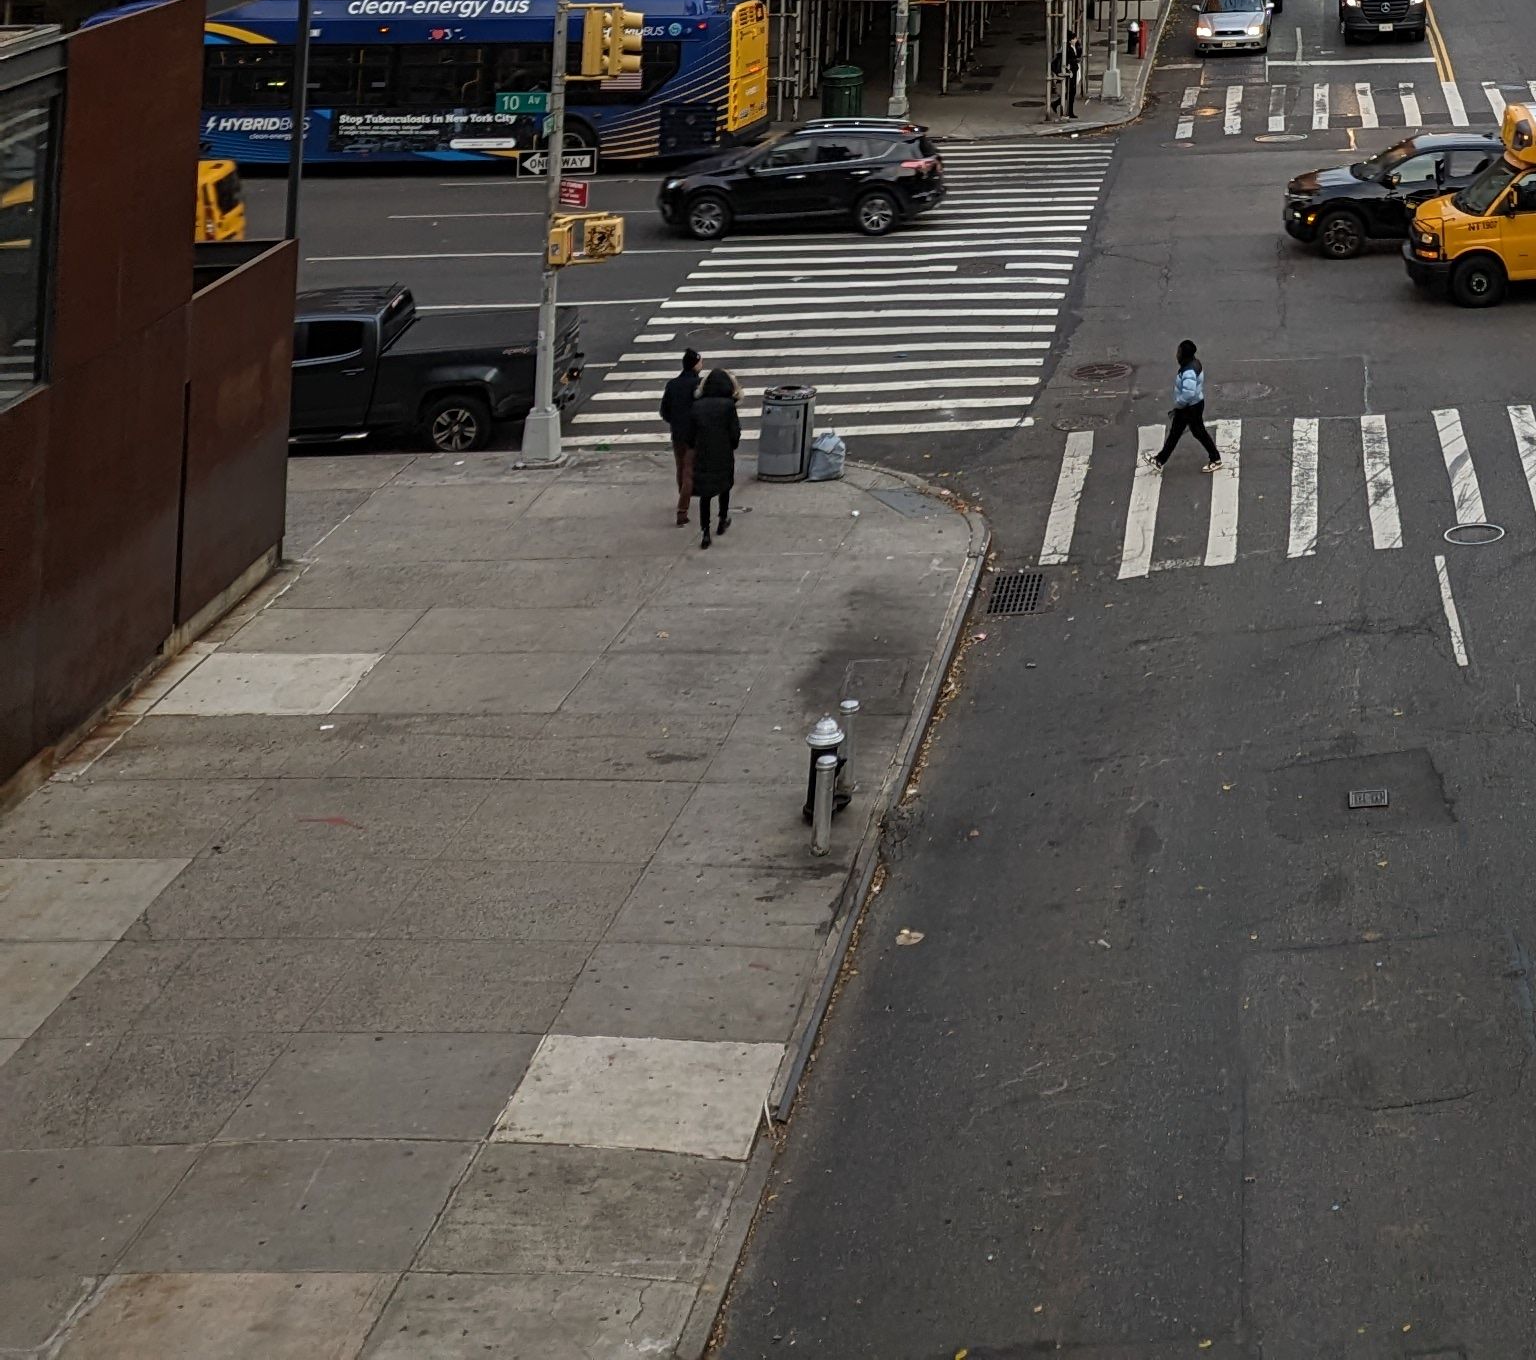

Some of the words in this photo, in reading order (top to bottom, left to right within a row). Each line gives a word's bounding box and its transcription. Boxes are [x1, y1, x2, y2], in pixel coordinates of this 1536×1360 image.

[348, 0, 486, 18] clean-energy
[490, 0, 530, 14] bus
[502, 95, 520, 110] 10
[528, 95, 541, 105] Av
[339, 114, 364, 126] Stop
[364, 113, 432, 124] Tuberculosis
[432, 114, 444, 123] in
[444, 113, 469, 123] New
[469, 113, 493, 123] York
[494, 113, 517, 125] City
[561, 157, 586, 168] WAY
